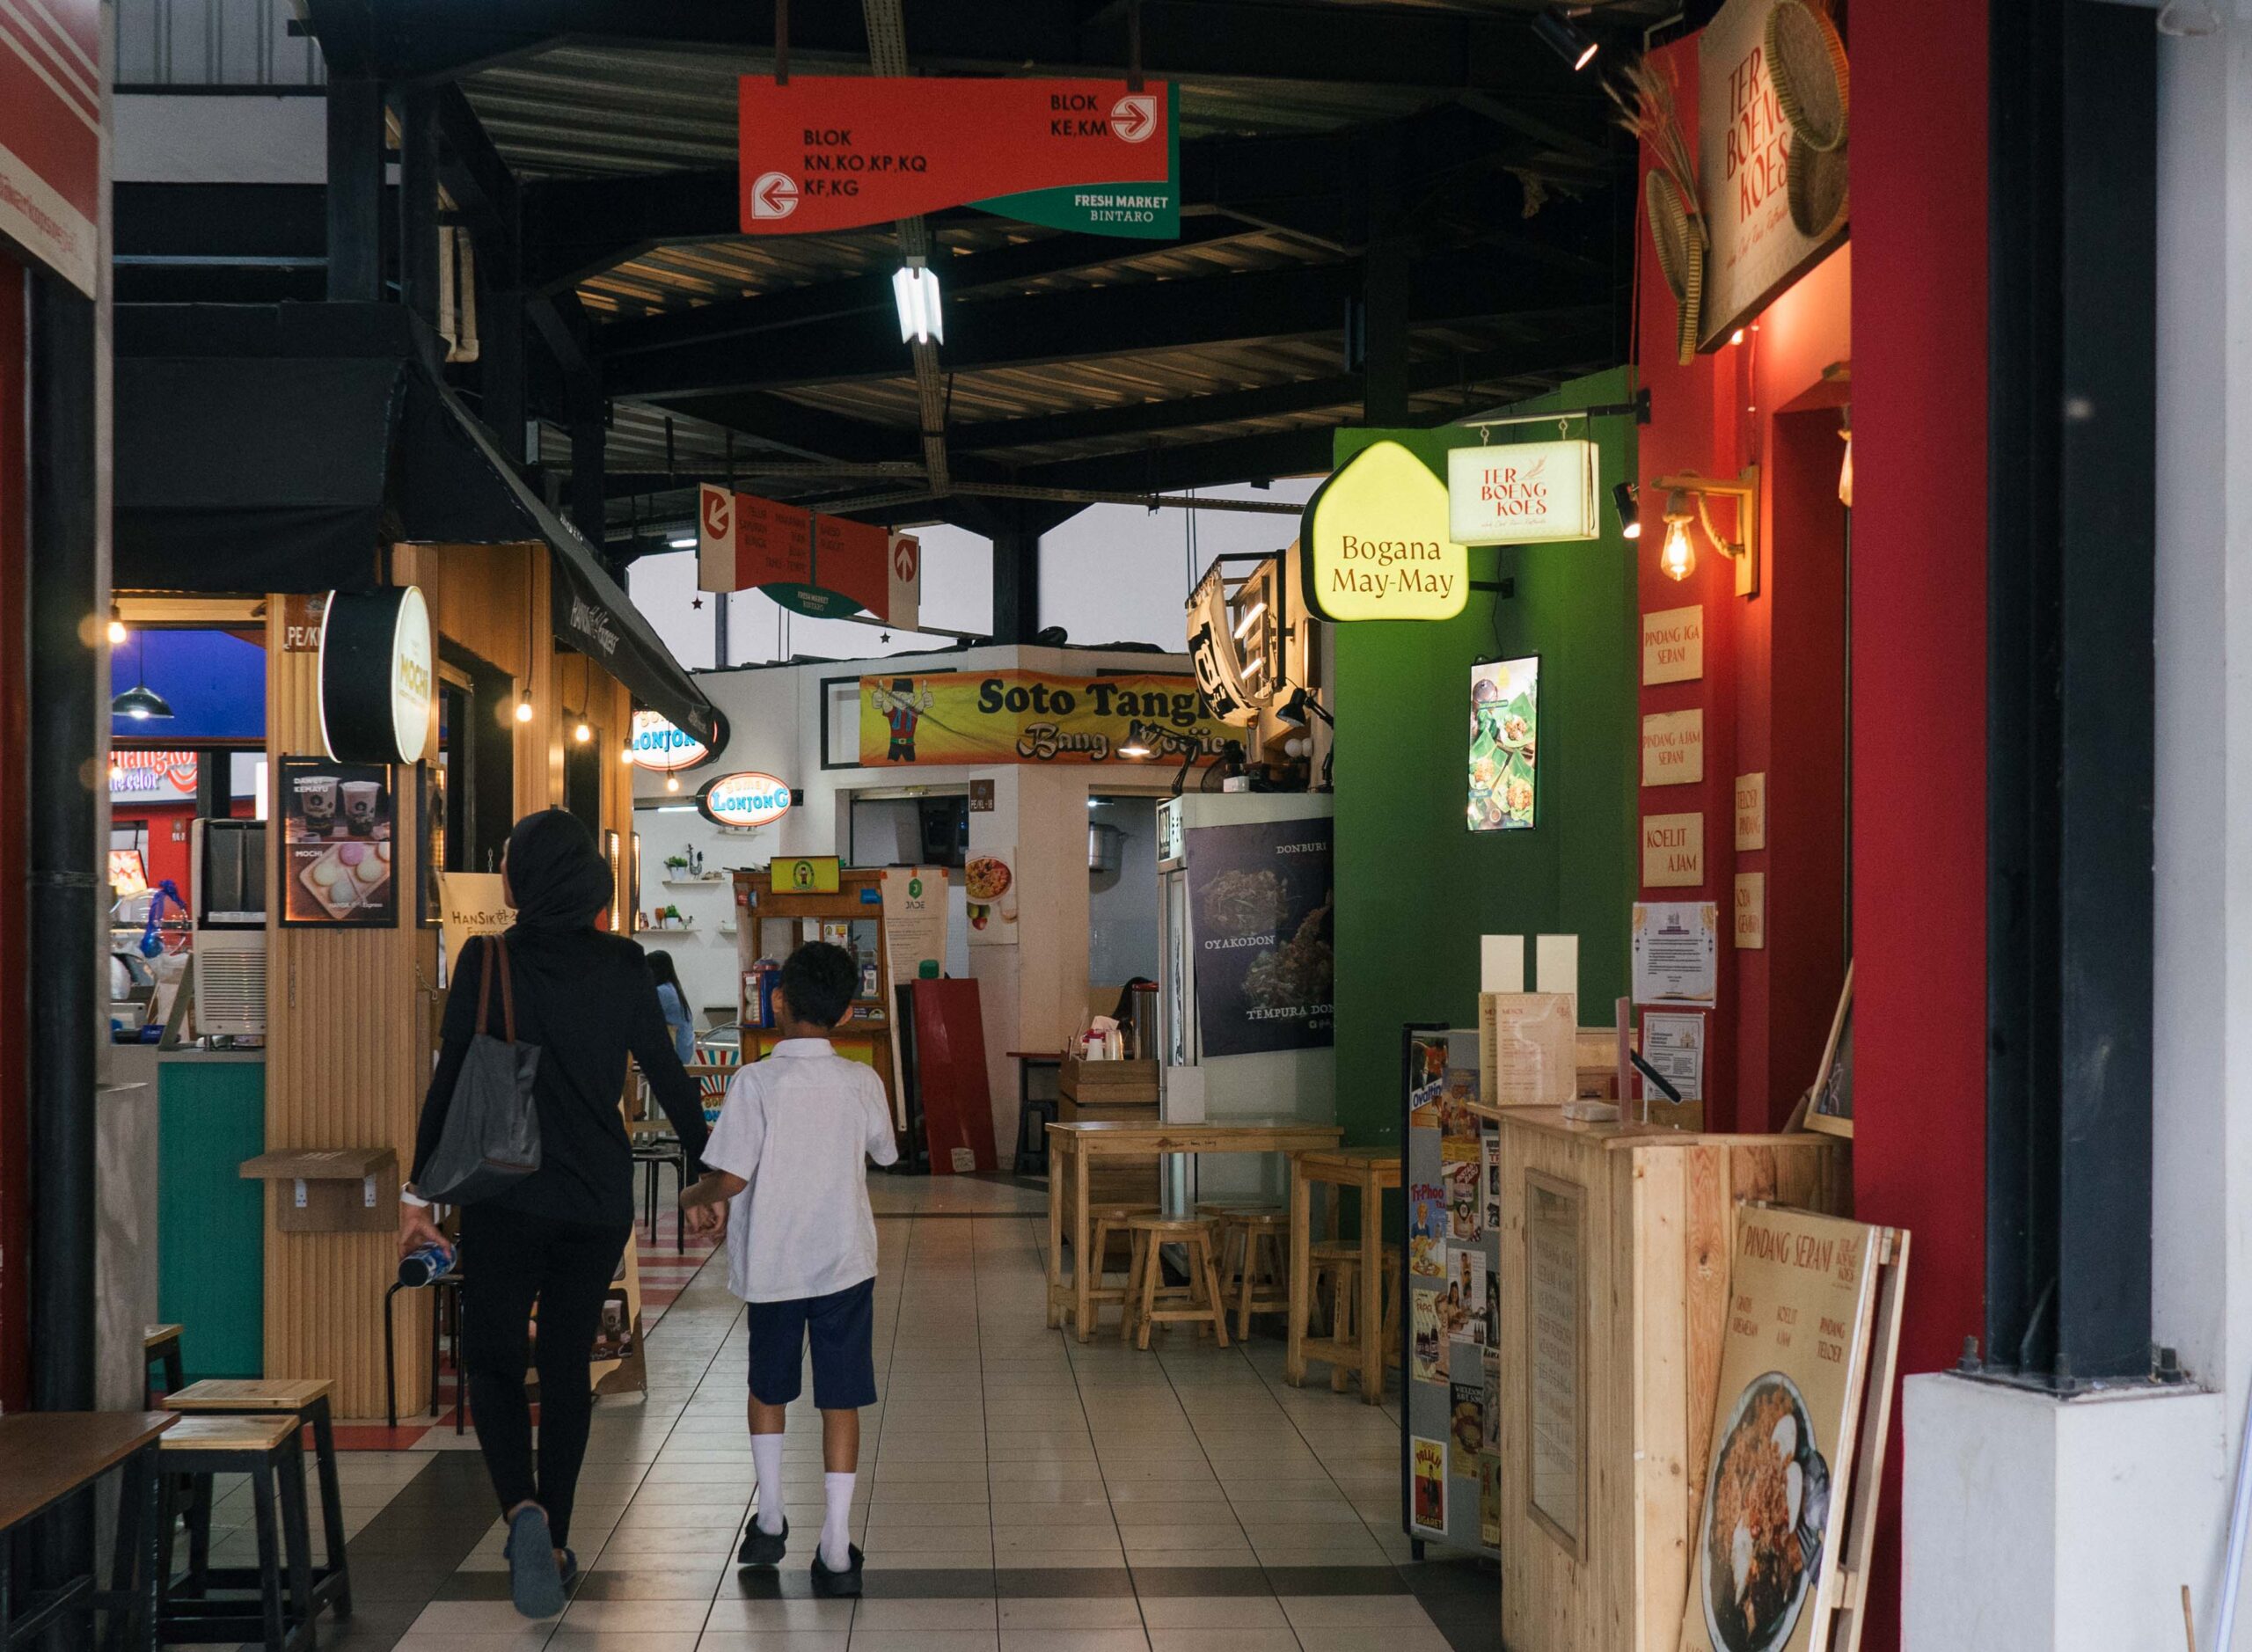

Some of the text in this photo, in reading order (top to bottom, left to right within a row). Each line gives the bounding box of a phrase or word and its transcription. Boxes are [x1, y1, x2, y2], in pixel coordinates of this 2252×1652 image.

[1728, 48, 1762, 122] TER
[1050, 94, 1099, 111] BLOK
[803, 129, 852, 146] BLOK
[1740, 131, 1789, 223] KOES
[1075, 194, 1168, 208] FRESH MARKET
[1090, 210, 1154, 223] BINTARO
[1481, 468, 1517, 485] TER
[1481, 482, 1546, 501] BOENG
[1497, 499, 1546, 516] KOES
[1342, 535, 1442, 567] Bogana
[1332, 568, 1454, 599] May-May
[288, 626, 322, 647] PE/K
[977, 678, 1075, 715] Soto
[1017, 722, 1109, 761] Bang
[1647, 828, 1687, 849] KOELIT
[1276, 842, 1327, 855] DONBURI
[1668, 853, 1697, 872] AJAM
[905, 901, 925, 910] JADE
[1204, 934, 1276, 950] OYAKODON
[1246, 1005, 1308, 1020] TEMPURA
[1414, 1082, 1442, 1108] Ovaltin
[1744, 1225, 1791, 1264] PINDANG
